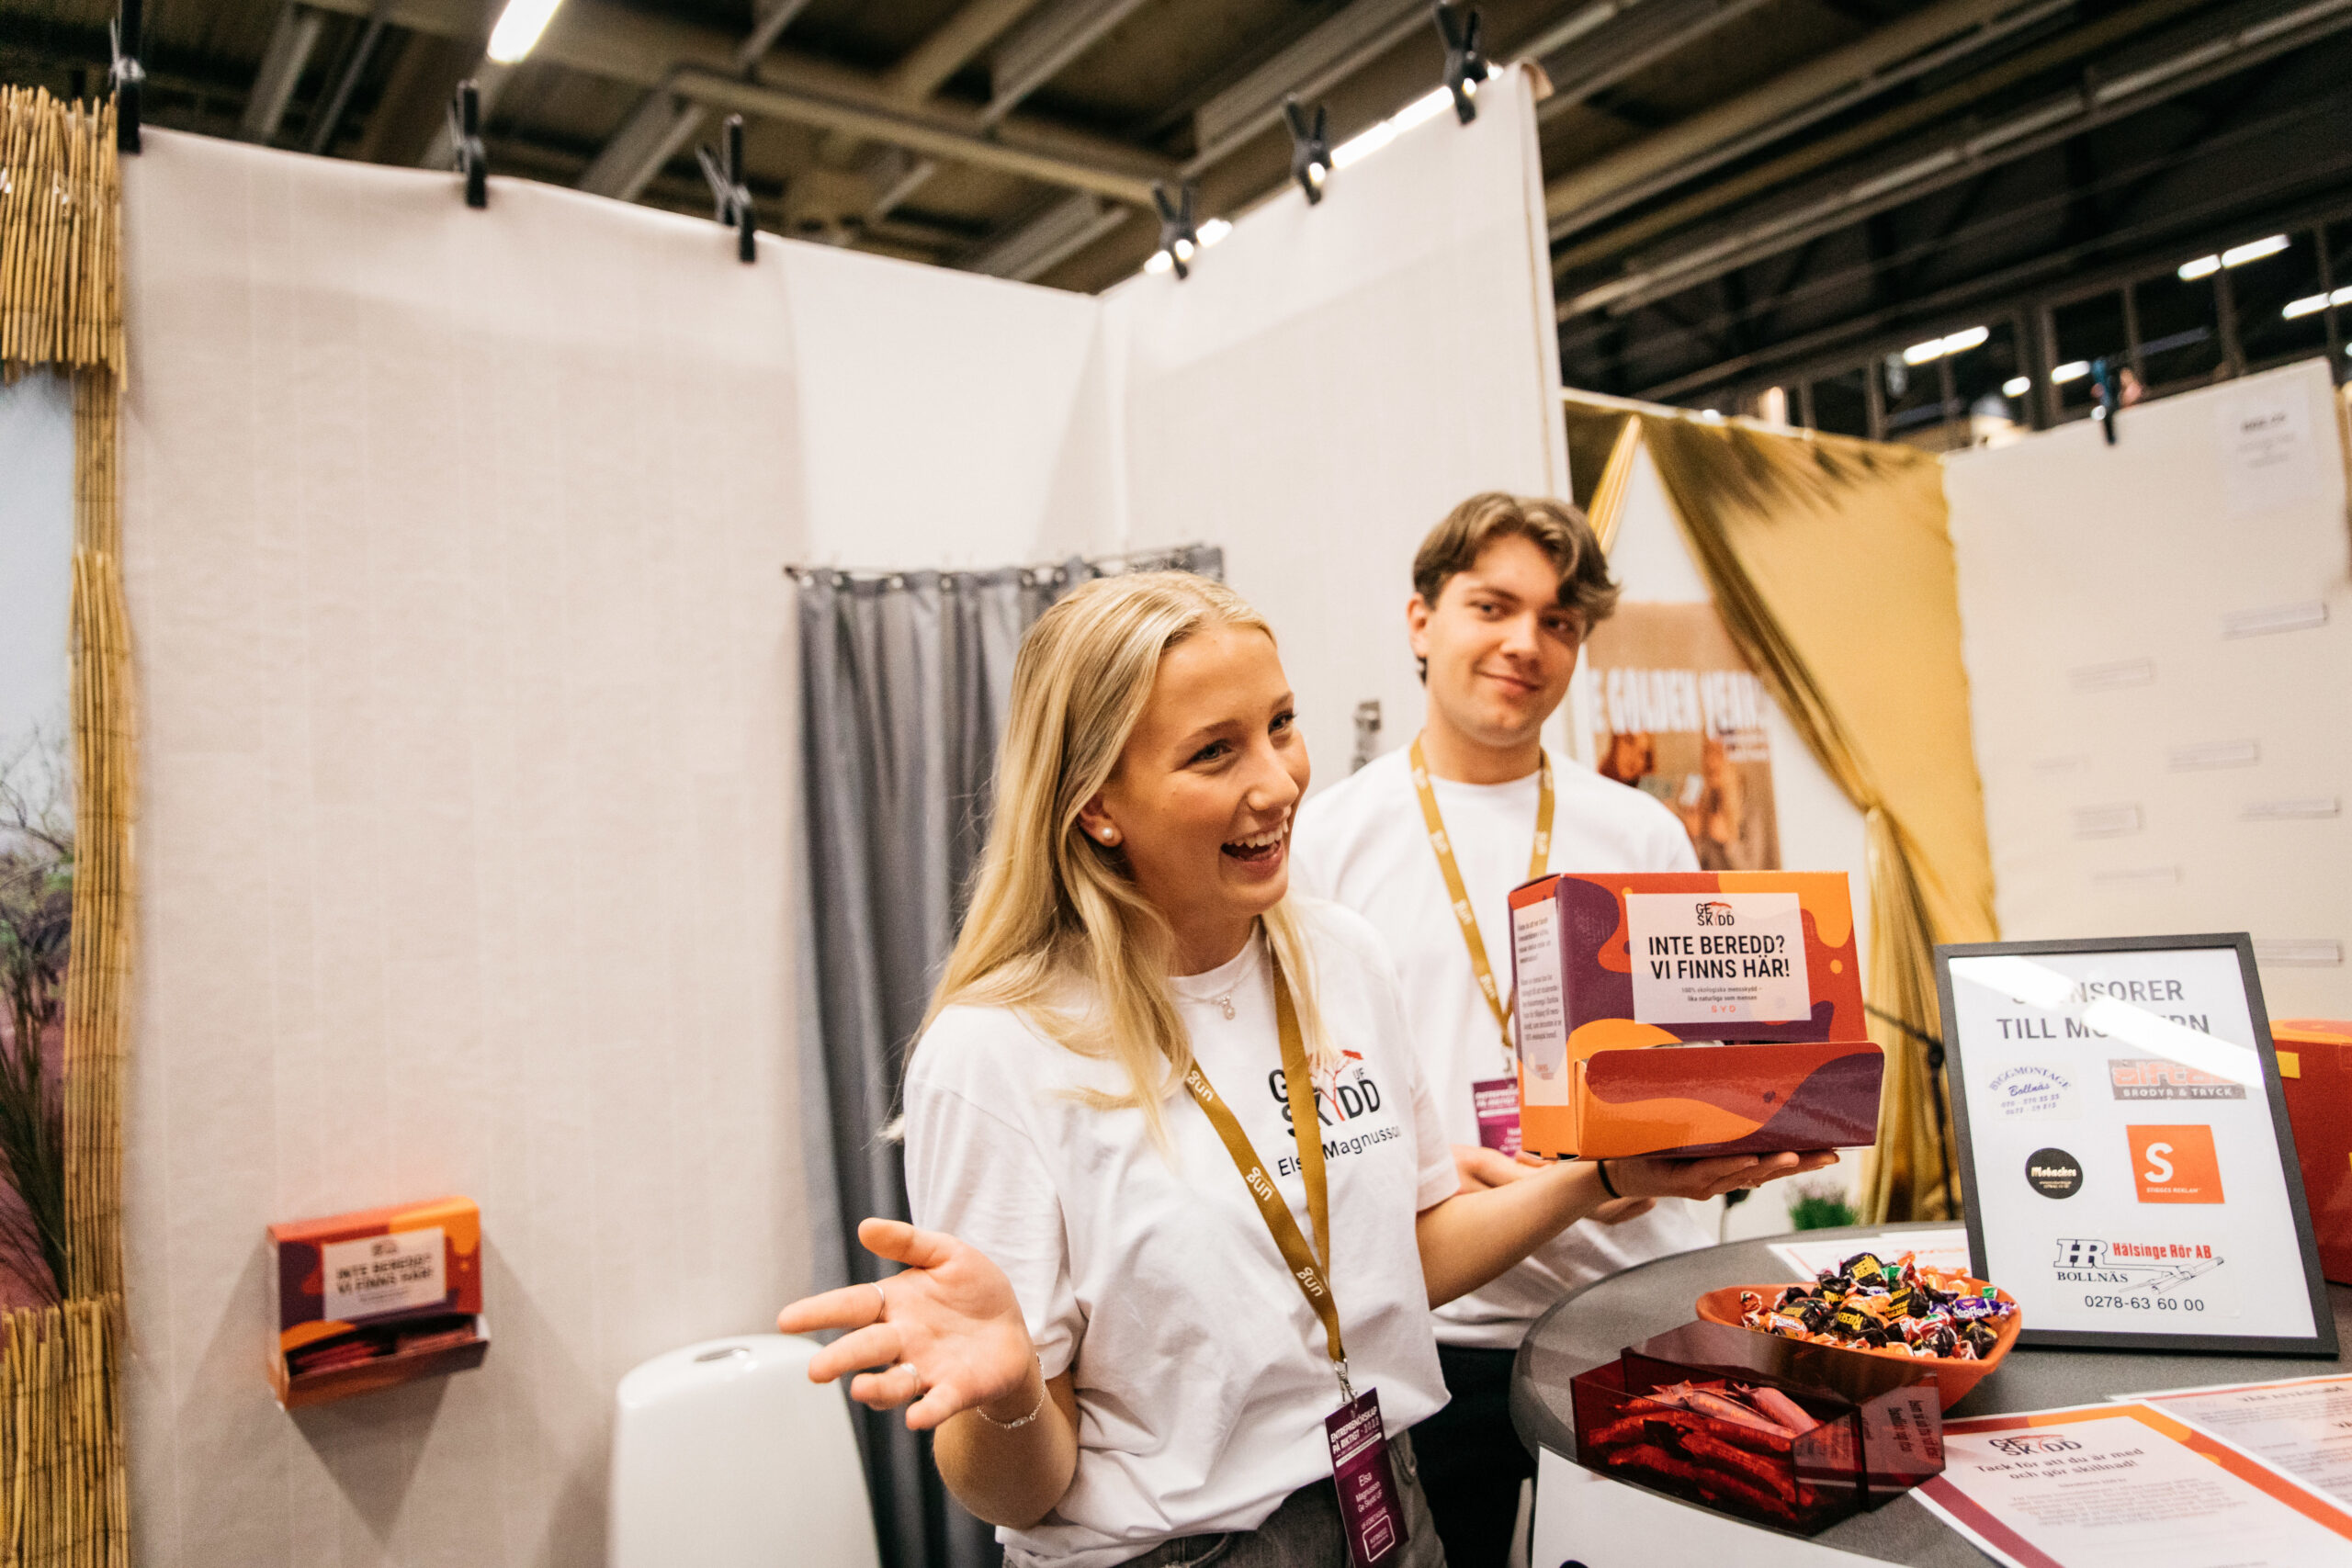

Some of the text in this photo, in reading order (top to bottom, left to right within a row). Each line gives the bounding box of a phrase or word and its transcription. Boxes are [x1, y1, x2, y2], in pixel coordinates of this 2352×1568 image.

[1649, 935, 1785, 955] INTE BEREDD?
[1651, 954, 1790, 979] VI FINNS HÄR!
[1996, 1018, 2057, 1040] TILL
[2191, 1088, 2233, 1096] TRYCK
[1278, 1125, 1402, 1177] Els Magnusso
[2144, 1142, 2174, 1183] S
[2112, 1242, 2167, 1259] Hälsinge
[2169, 1244, 2192, 1258] Rör
[2196, 1245, 2211, 1259] AB
[2057, 1270, 2129, 1282] BOLLNÄS
[2085, 1295, 2205, 1312] 0278-63 60 00
[1976, 1463, 2013, 1472] Tack
[2045, 1458, 2065, 1467] att
[2068, 1455, 2087, 1464] du
[2111, 1448, 2145, 1459] med
[1358, 1472, 1373, 1486] Elsa
[2009, 1470, 2038, 1480] och
